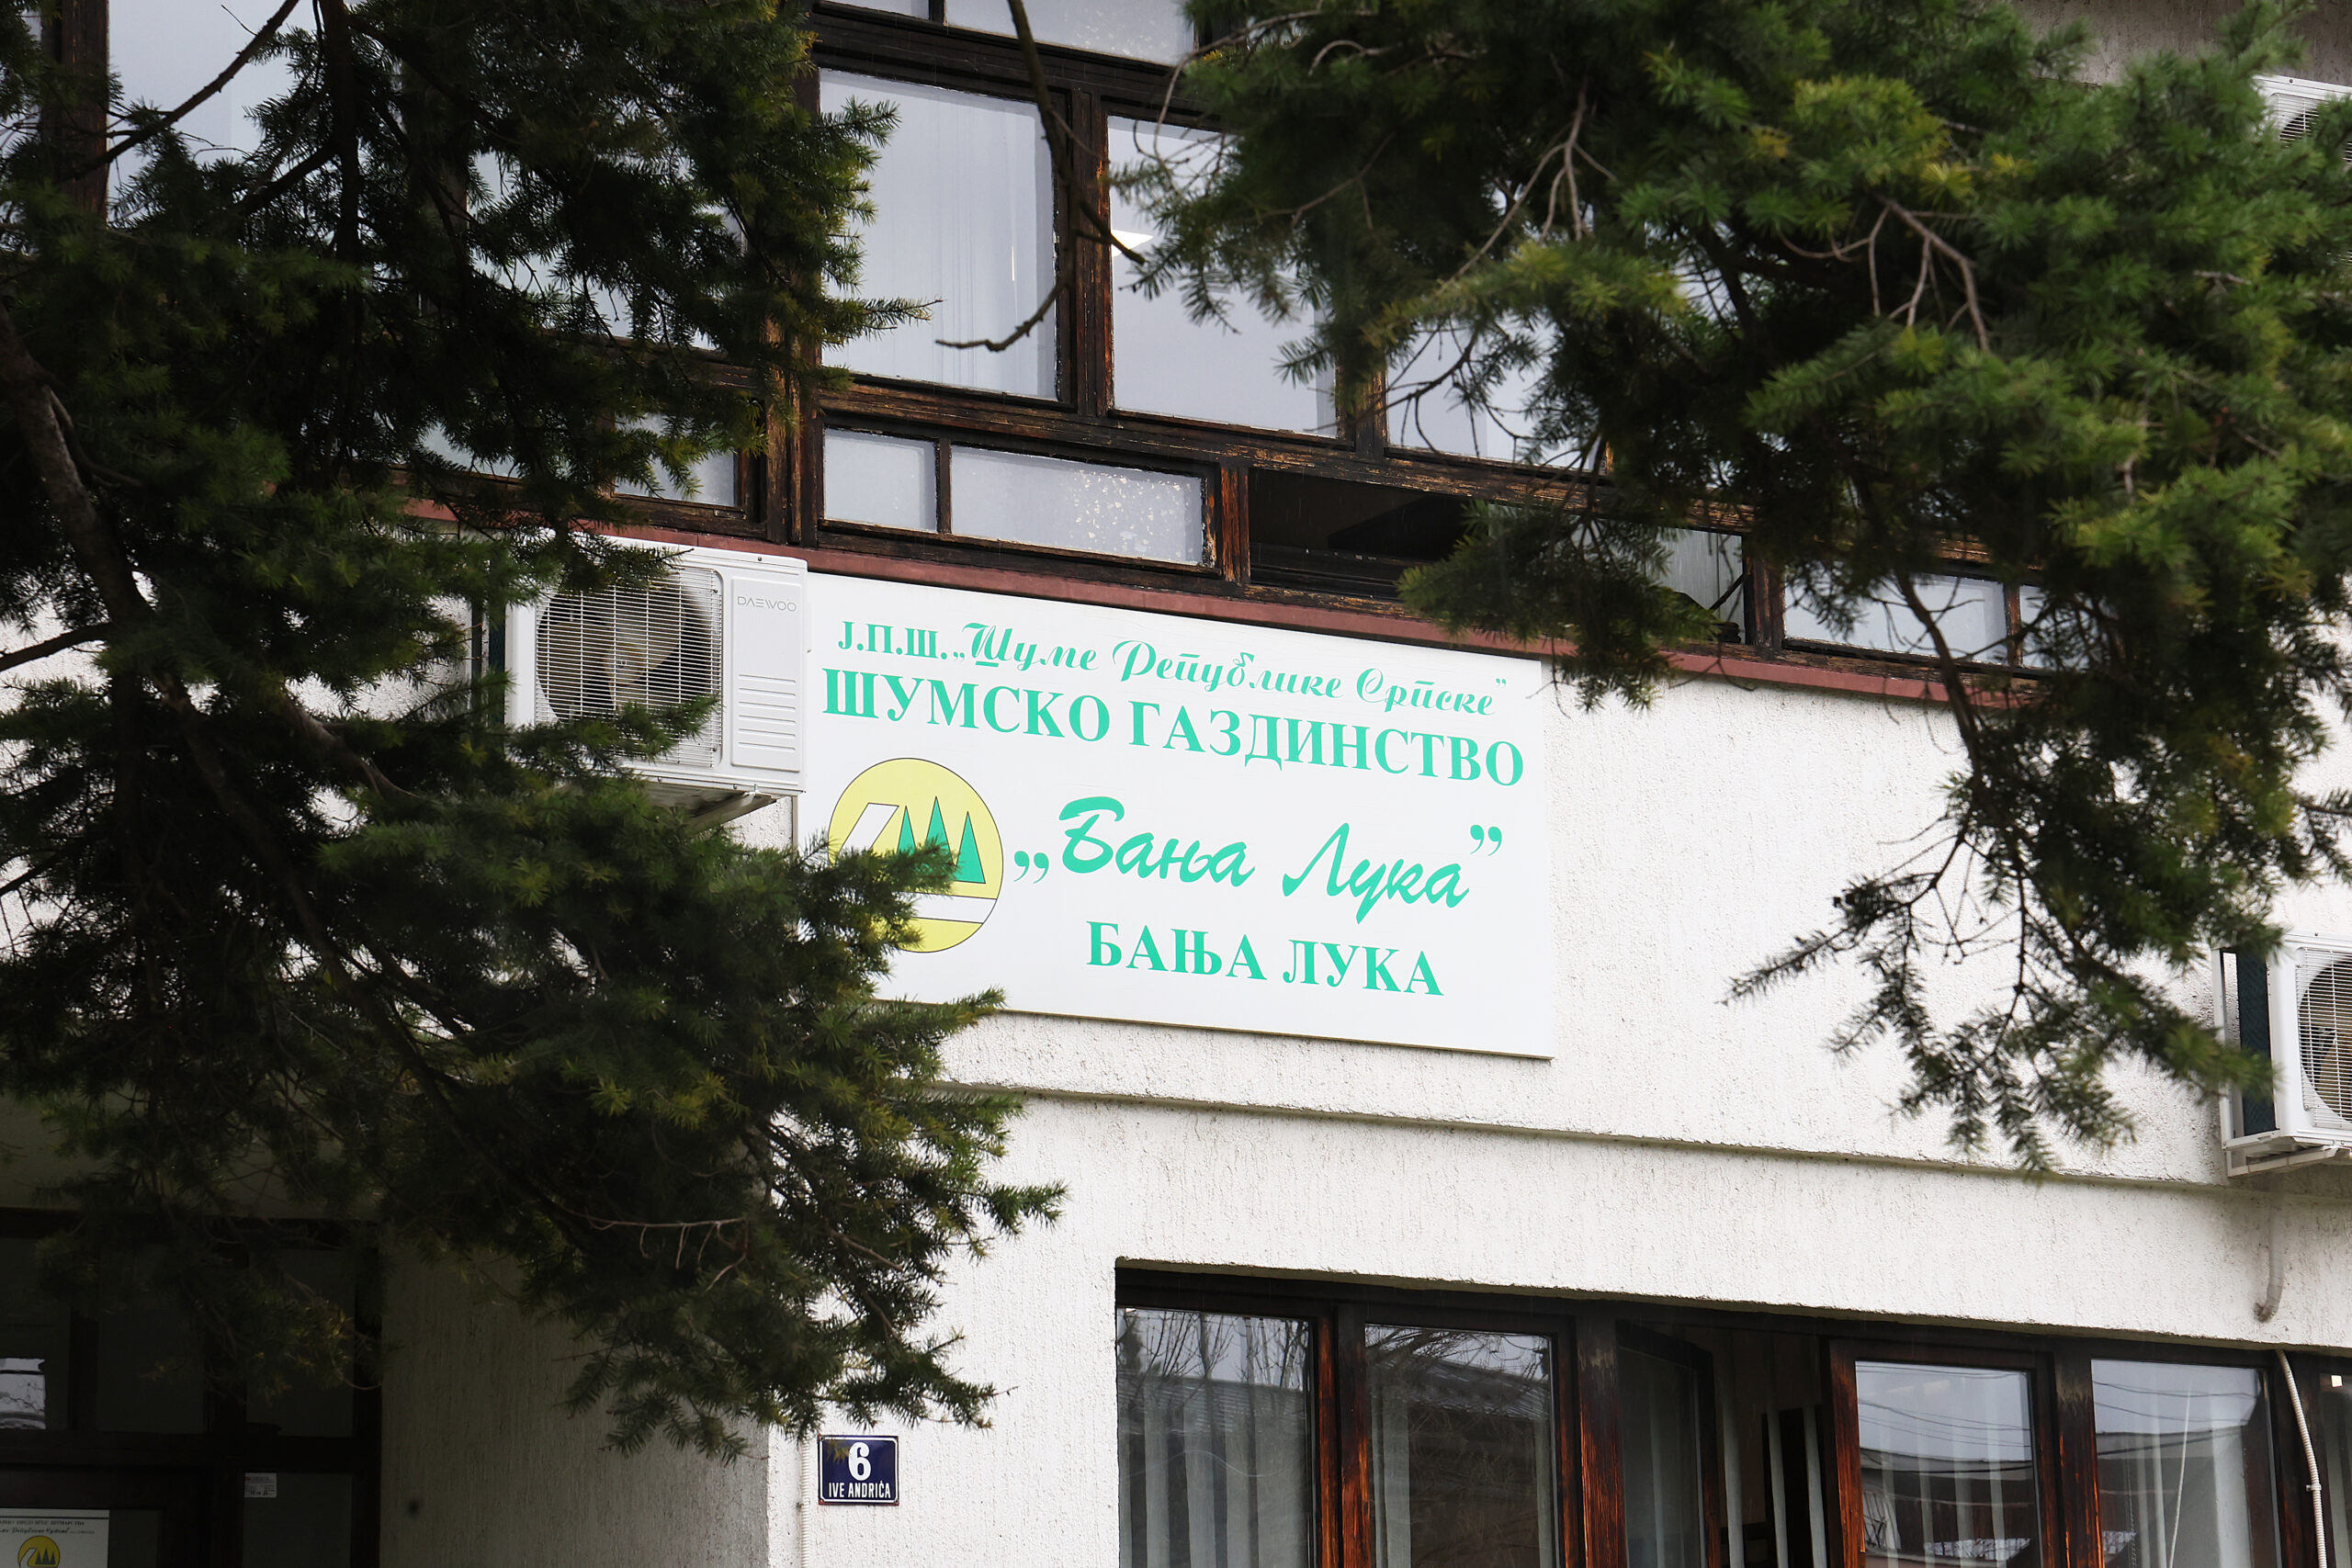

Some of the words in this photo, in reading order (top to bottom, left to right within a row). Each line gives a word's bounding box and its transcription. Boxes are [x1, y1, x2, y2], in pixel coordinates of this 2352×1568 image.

[737, 595, 797, 613] DAEWOO
[1112, 639, 1344, 699] Републике
[821, 668, 1111, 742] ШУМСКО
[1128, 700, 1524, 787] ГАЗДИНСТВО
[1087, 921, 1268, 981] БАЊА
[1282, 939, 1444, 997] ЛУКА
[848, 1441, 872, 1482] 6
[828, 1482, 845, 1498] IVE
